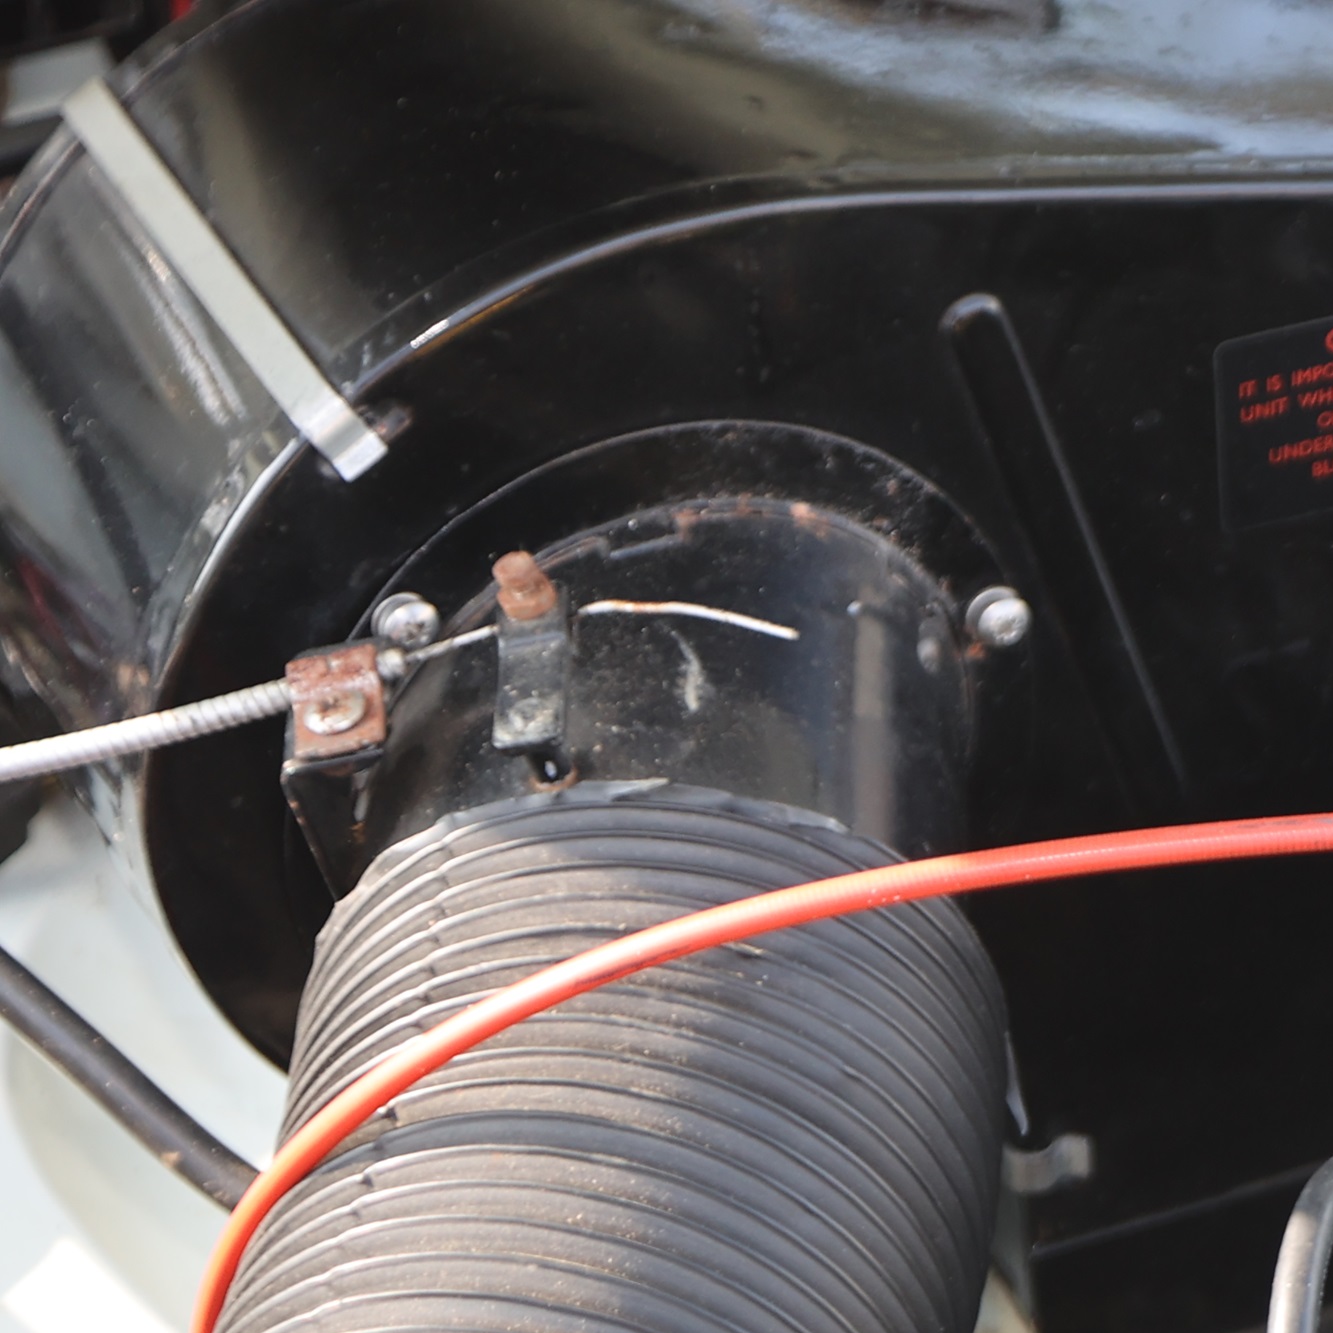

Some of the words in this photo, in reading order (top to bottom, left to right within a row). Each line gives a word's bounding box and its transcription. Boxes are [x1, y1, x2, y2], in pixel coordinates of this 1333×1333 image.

[1239, 381, 1257, 398] IT
[1267, 375, 1281, 392] IS
[1240, 397, 1289, 422] UNIT
